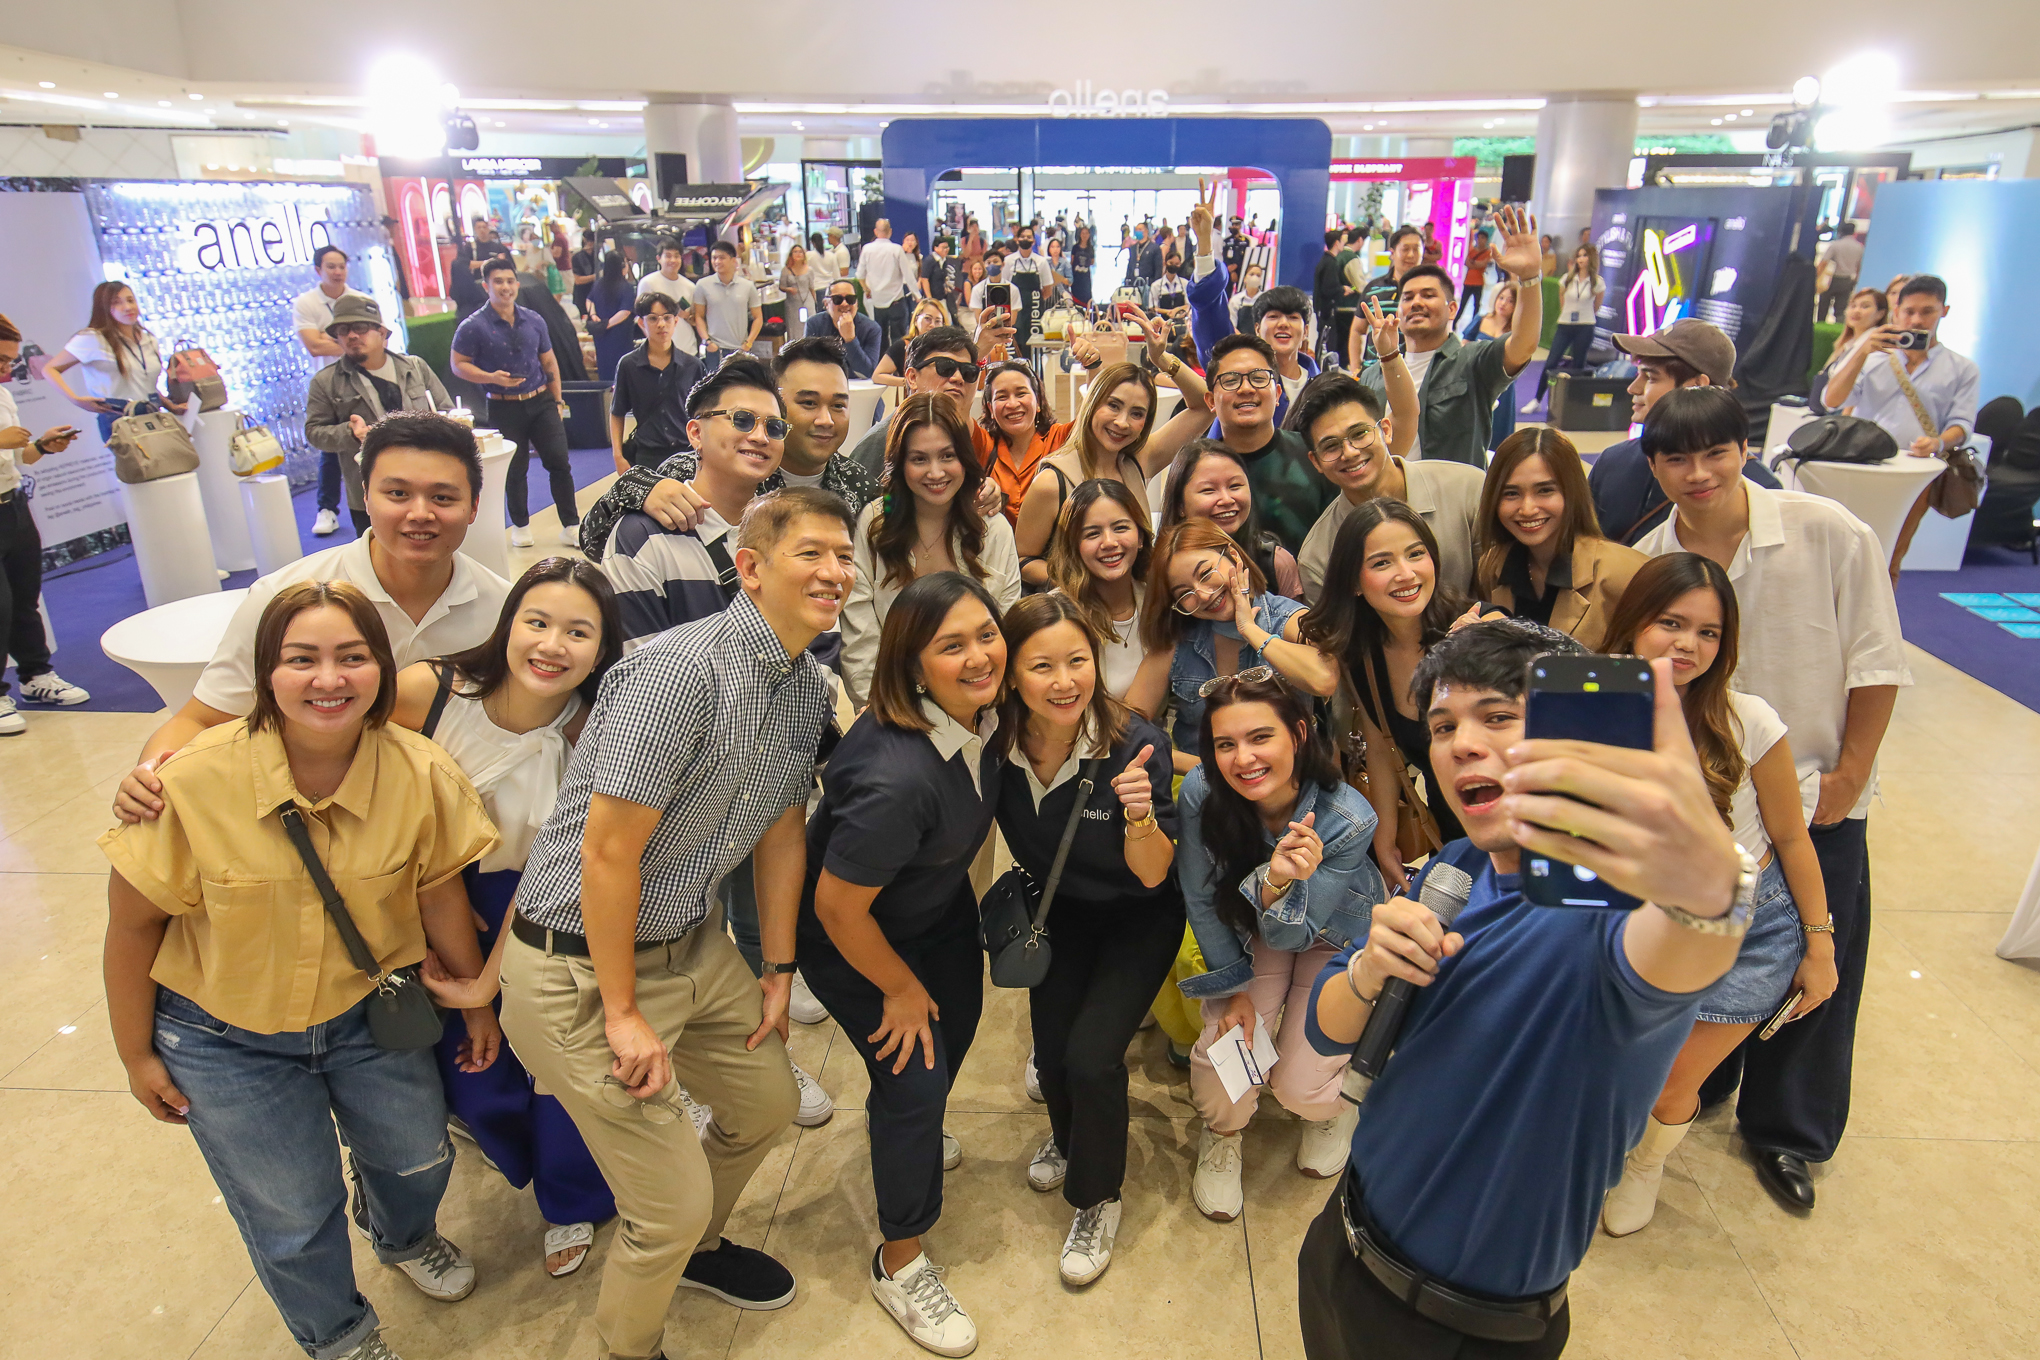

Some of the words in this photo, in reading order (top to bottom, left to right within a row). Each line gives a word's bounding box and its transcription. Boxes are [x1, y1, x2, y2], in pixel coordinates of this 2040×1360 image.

[674, 196, 718, 207] COFFEE
[194, 202, 331, 269] anello
[1030, 290, 1041, 335] anello
[1081, 808, 1110, 820] nello
